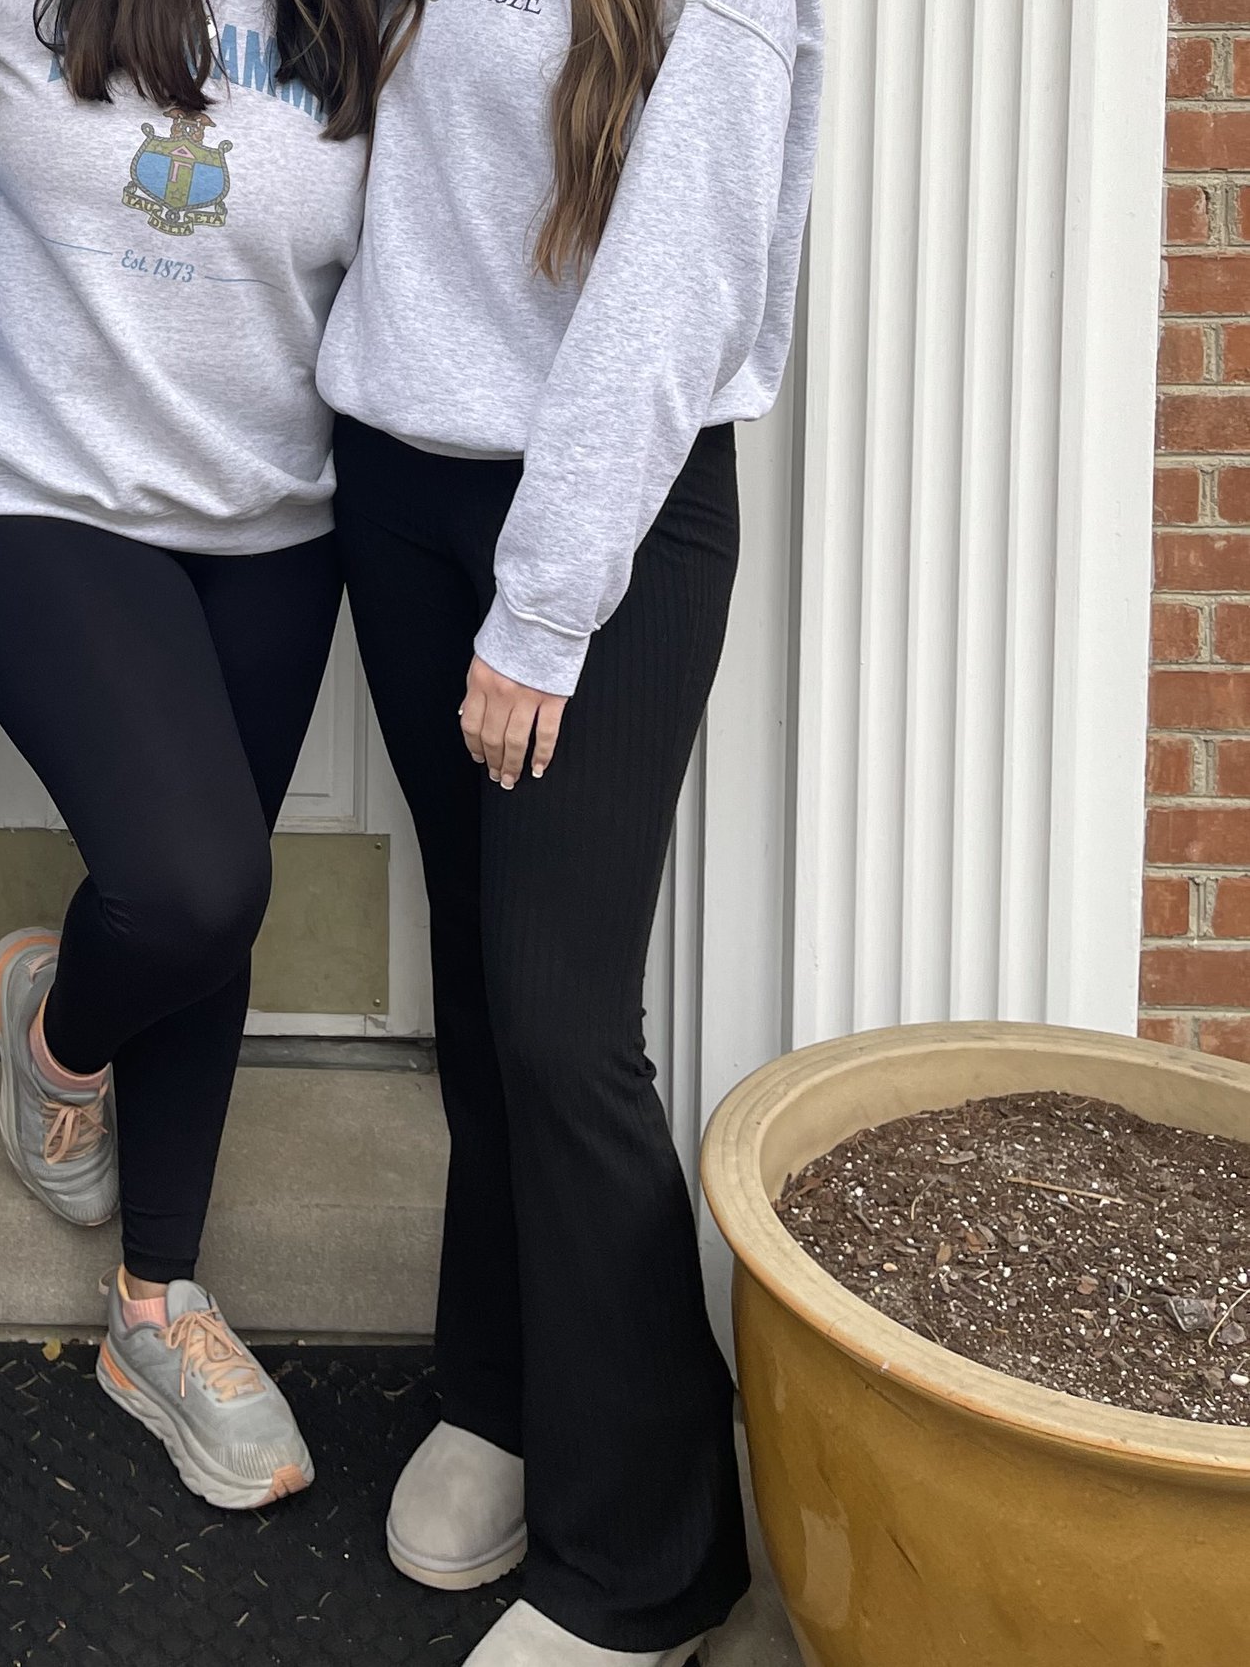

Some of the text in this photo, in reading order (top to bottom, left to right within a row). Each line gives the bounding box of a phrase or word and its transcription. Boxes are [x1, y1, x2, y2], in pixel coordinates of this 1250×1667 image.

[150, 216, 193, 234] DELTA
[121, 249, 195, 282] Est. 1873
